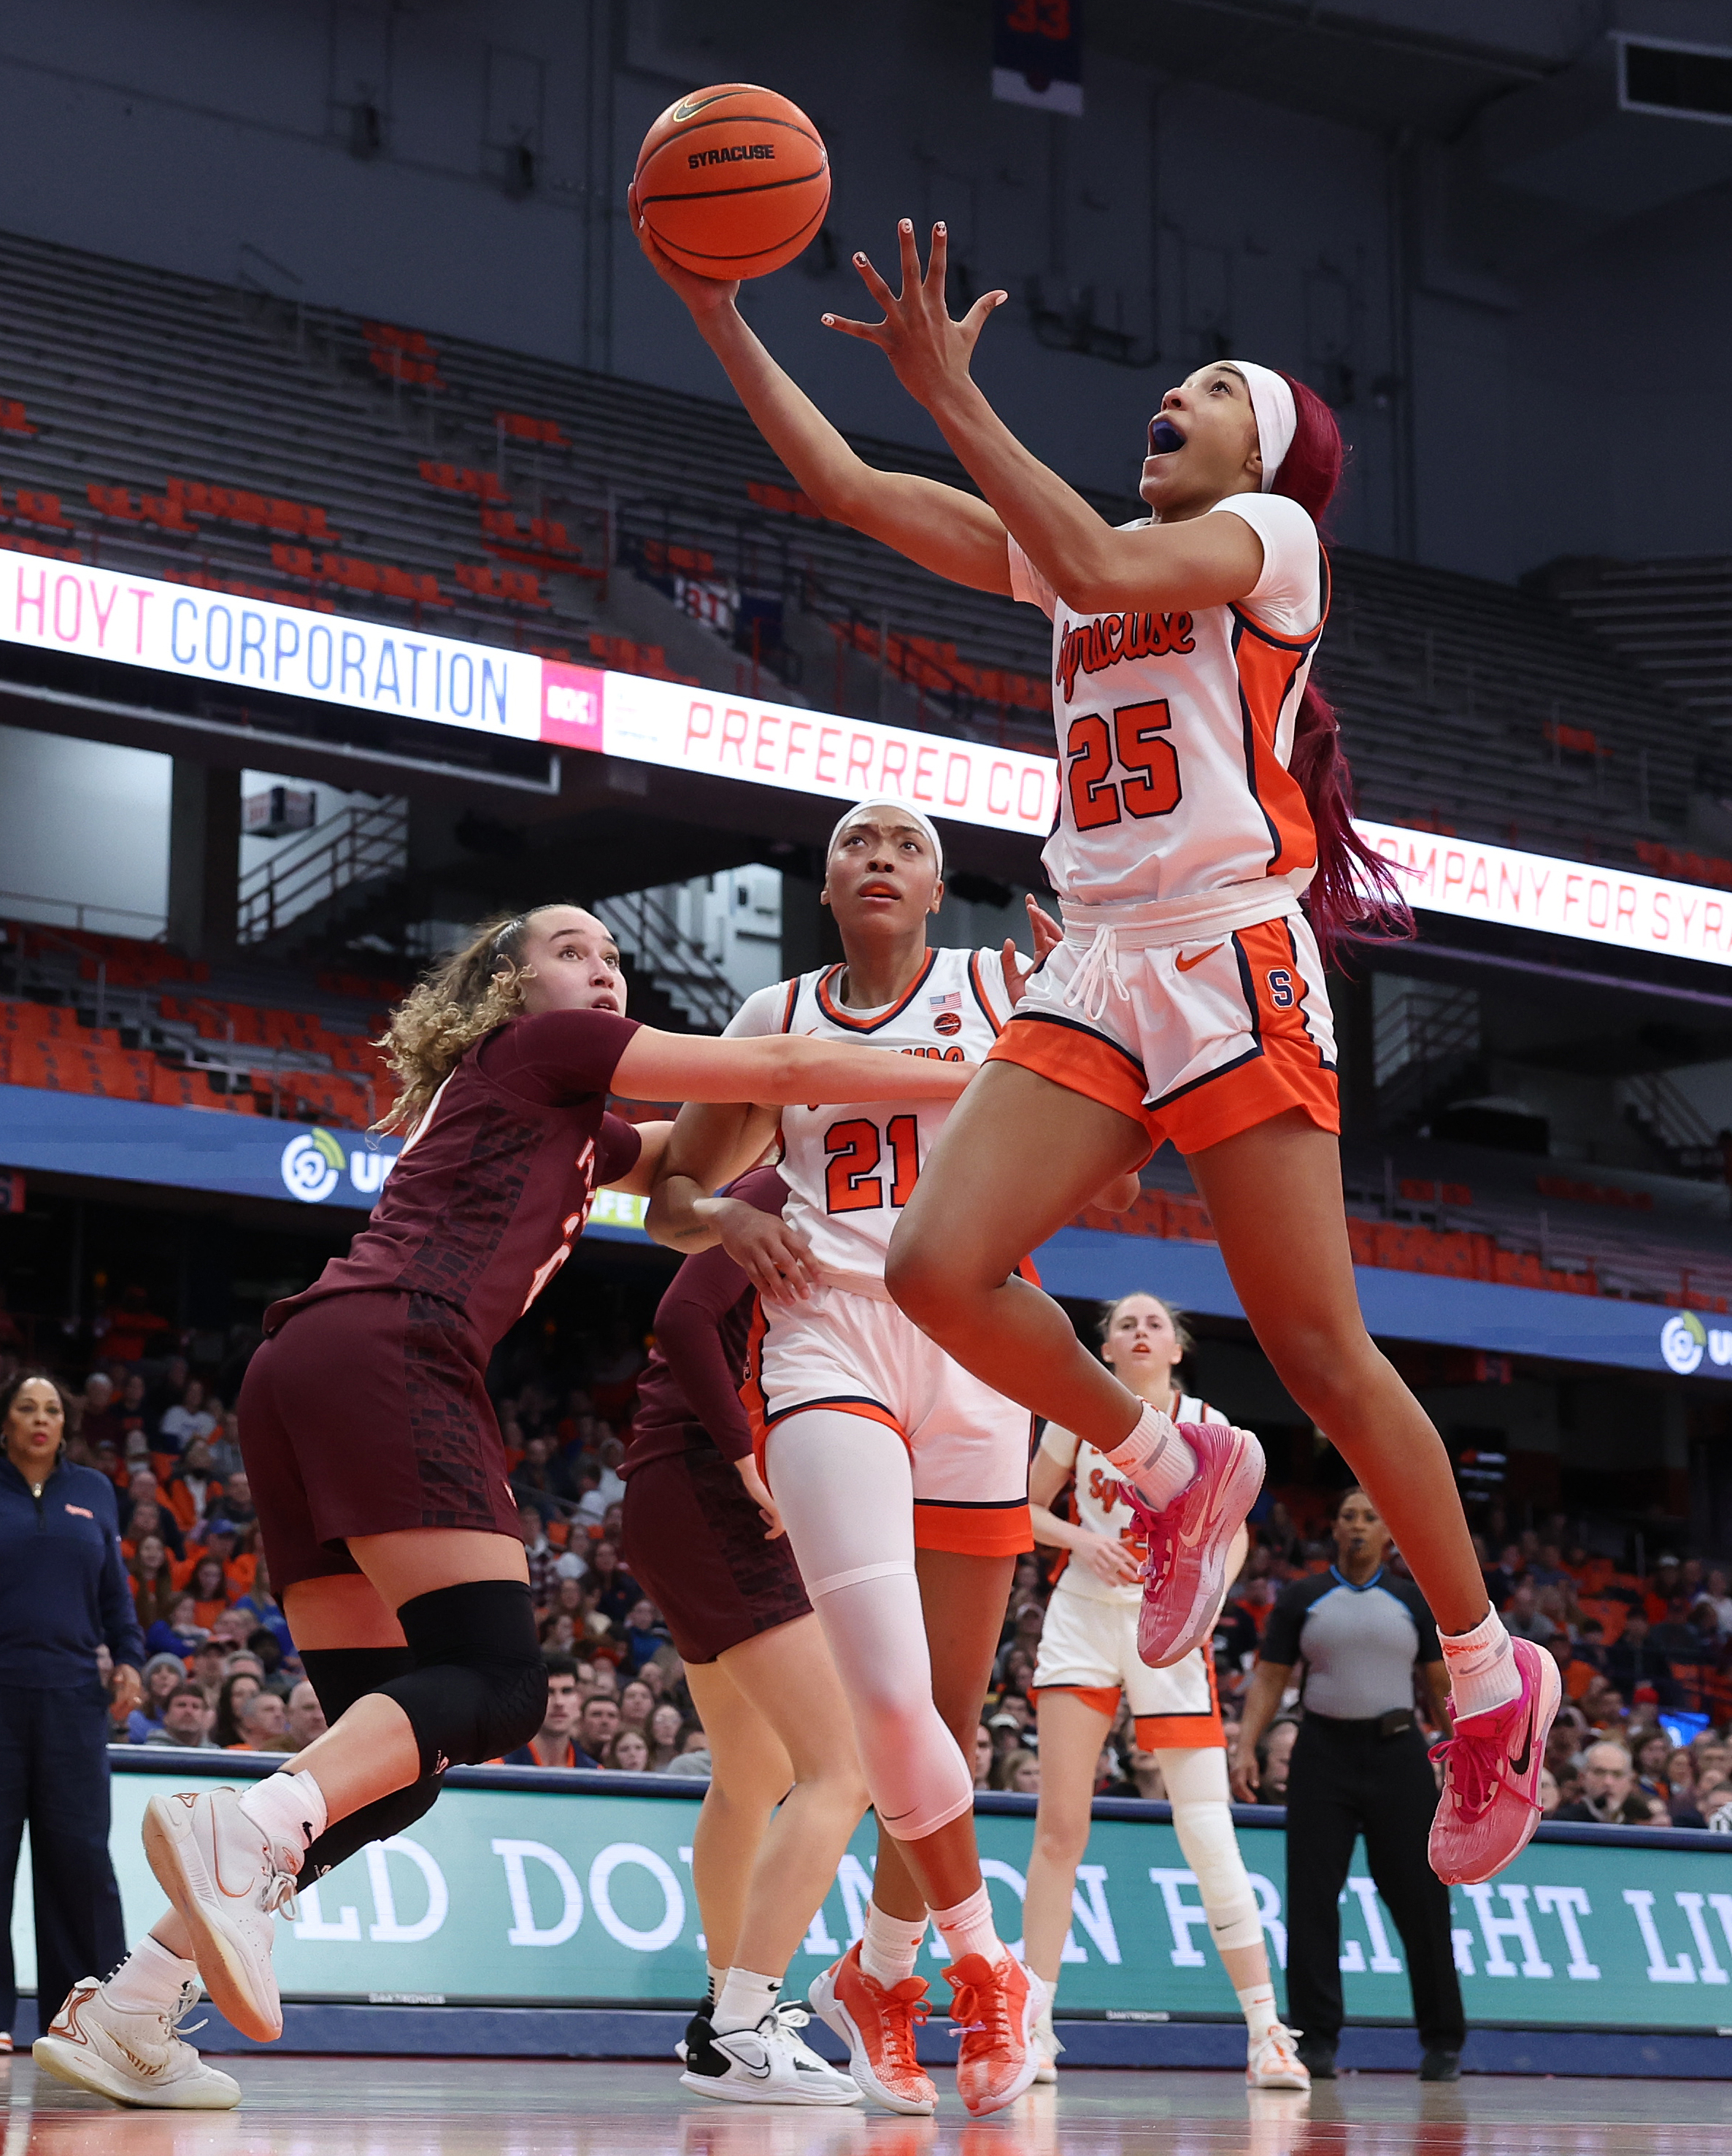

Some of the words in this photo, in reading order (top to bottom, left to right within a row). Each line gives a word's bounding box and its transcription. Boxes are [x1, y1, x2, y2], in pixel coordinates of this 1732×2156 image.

[688, 144, 775, 170] SYRACUSE
[15, 565, 154, 654] HOYT
[170, 597, 509, 725] CORPORATION
[683, 701, 971, 808] PREFERRED
[988, 761, 1061, 821] CO
[1066, 698, 1183, 832] 25
[1563, 874, 1637, 935] FOR
[1651, 891, 1732, 952] SYR
[1267, 969, 1295, 1009] S
[823, 1114, 920, 1215] 21
